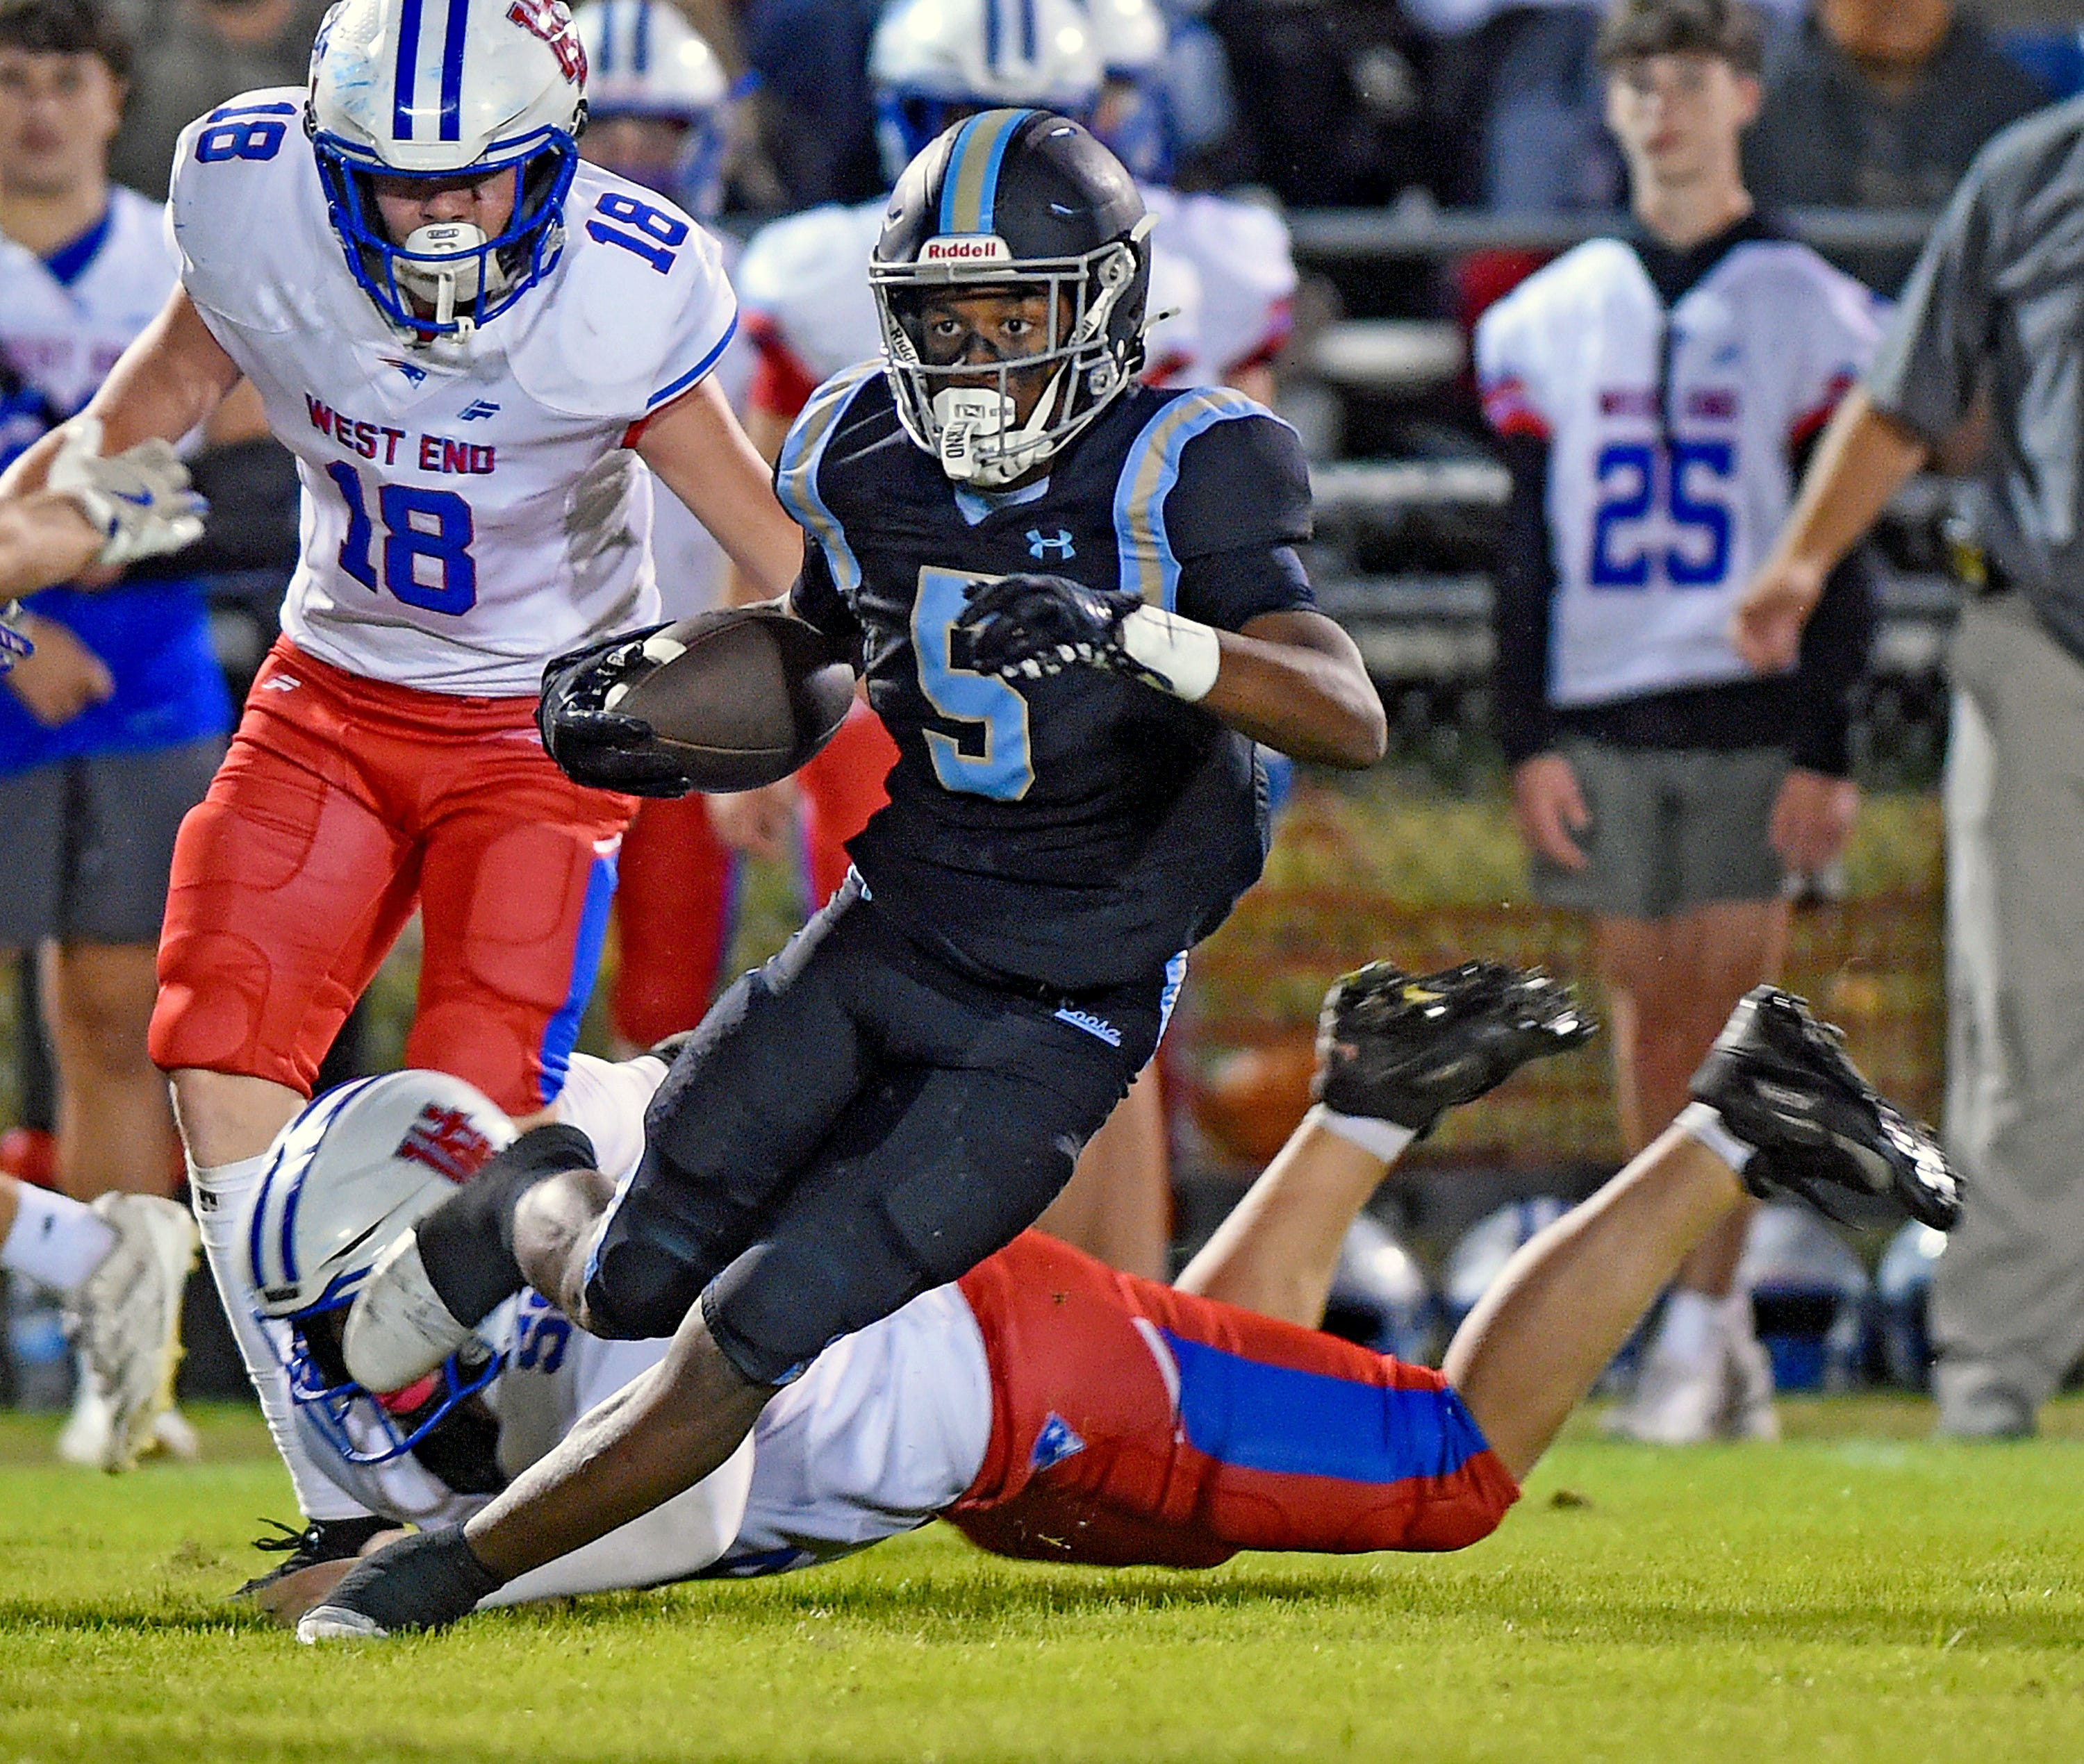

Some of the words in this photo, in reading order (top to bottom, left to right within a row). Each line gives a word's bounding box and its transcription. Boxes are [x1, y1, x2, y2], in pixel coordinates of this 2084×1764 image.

[195, 102, 297, 163] 18
[585, 192, 689, 274] 18
[929, 242, 995, 258] Riddell
[305, 392, 406, 465] WEST
[419, 433, 495, 474] END
[325, 459, 477, 616] 18
[1591, 442, 1733, 587] 25
[911, 565, 1035, 801] 5
